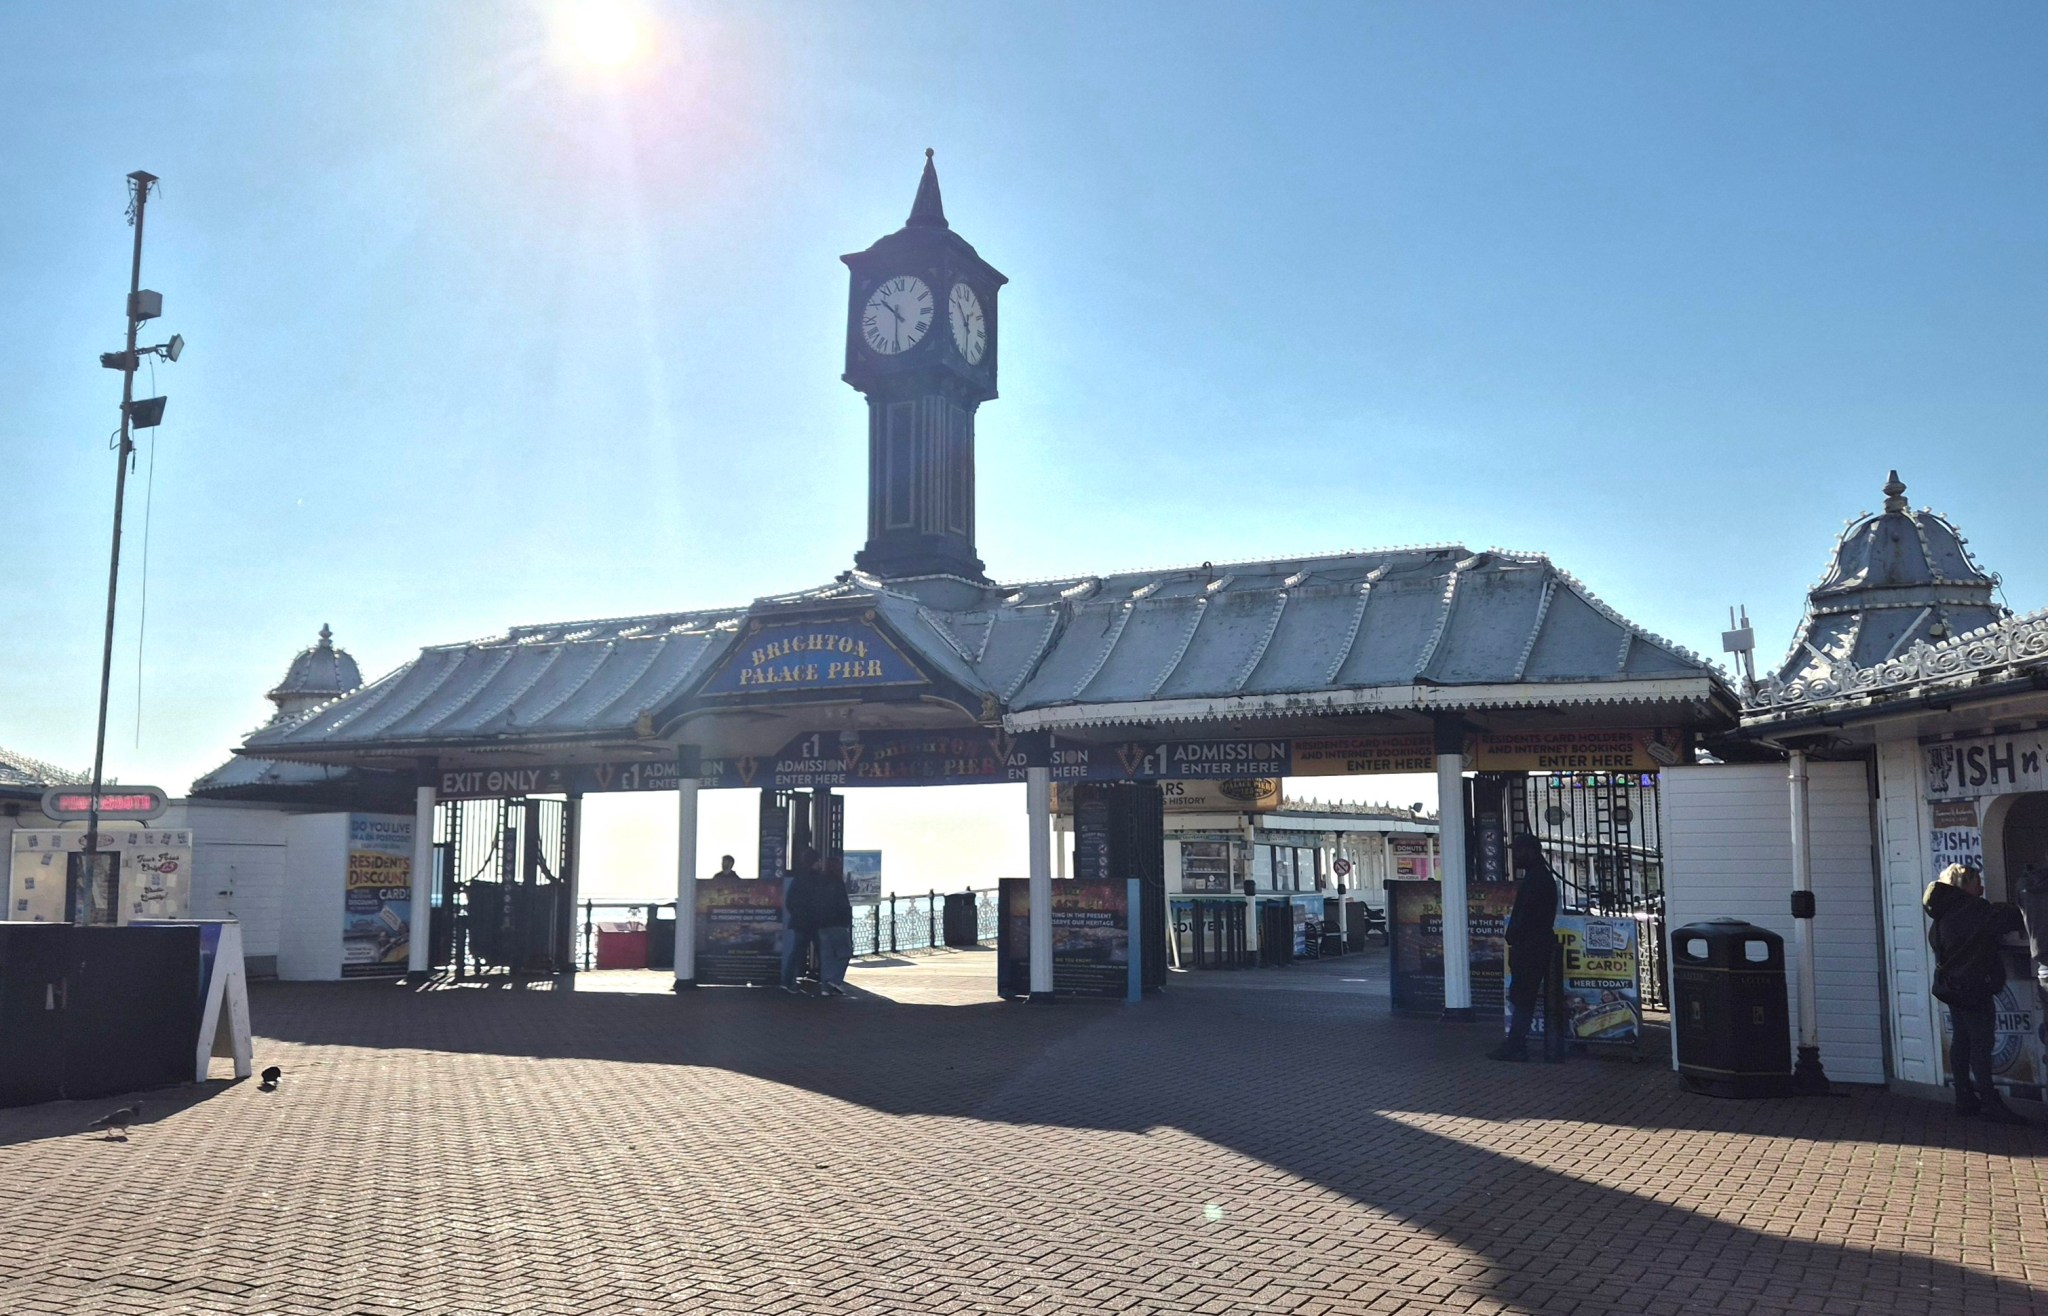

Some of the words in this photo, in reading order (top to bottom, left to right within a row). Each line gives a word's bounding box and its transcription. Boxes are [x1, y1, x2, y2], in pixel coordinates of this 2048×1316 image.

[752, 634, 867, 666] BRIGHTON
[740, 664, 818, 685] PALACE
[828, 660, 882, 679] PIER
[1295, 739, 1349, 750] RESIDENTS
[1351, 738, 1379, 749] CARD
[1382, 735, 1432, 747] HOLDERS
[1482, 734, 1541, 744] RESIDENTS
[1543, 733, 1576, 743] CARD
[1581, 732, 1633, 742] HOLDERS
[802, 733, 820, 758] £1
[1487, 744, 1512, 754] AND
[1515, 743, 1569, 754] INTERNET
[1572, 742, 1633, 753] BOOKINGS
[1143, 744, 1167, 775] £1
[1174, 742, 1285, 761] ADMISSION
[1301, 750, 1323, 760] AND
[1325, 749, 1374, 759] INTERNET
[1376, 747, 1432, 758] BOOKINGS
[775, 759, 847, 772] ADMISSION
[944, 757, 996, 776] PIER
[1347, 759, 1391, 771] ENTER
[1395, 757, 1432, 770] HERE
[1539, 755, 1587, 767] ENTER
[1591, 755, 1633, 766] HERE
[1927, 742, 2016, 793] FISH
[1053, 766, 1088, 777] HERE
[1181, 763, 1231, 774] ENTER
[1237, 762, 1279, 773] HERE
[443, 771, 484, 792] EXIT
[487, 770, 540, 791] ONLY
[622, 763, 639, 789] £1
[775, 775, 812, 784] ENTER
[815, 774, 846, 784] HERE
[1169, 797, 1206, 805] HISTORY
[352, 821, 367, 831] DO
[369, 822, 390, 832] YOU
[392, 823, 411, 834] LIVE
[1931, 831, 1970, 852] FISH
[379, 888, 410, 900] CARD!
[1557, 934, 1576, 946] UP
[1587, 960, 1627, 972] CARD!
[1574, 980, 1597, 988] HERE
[1598, 980, 1629, 988] TODAY!
[1997, 1014, 2031, 1031] HIPS
